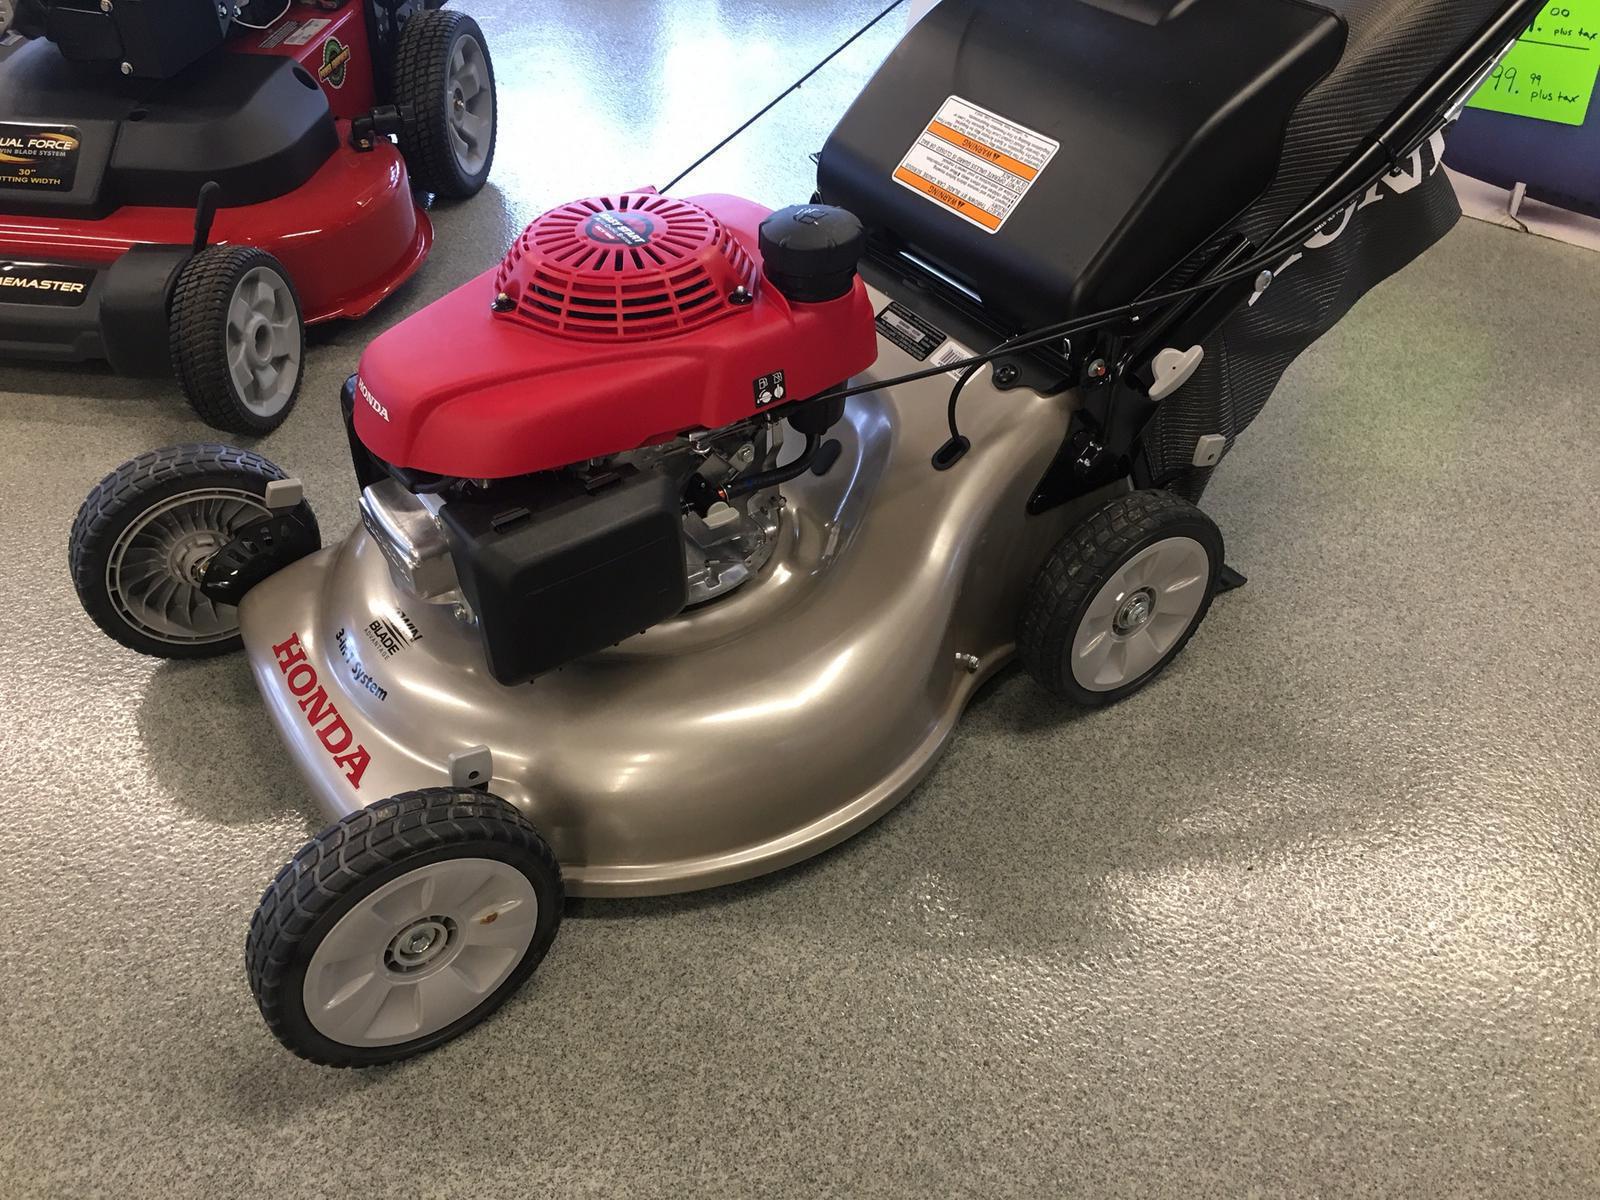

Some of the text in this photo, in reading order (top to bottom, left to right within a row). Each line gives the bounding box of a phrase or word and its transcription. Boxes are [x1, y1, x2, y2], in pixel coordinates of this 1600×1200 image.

[1554, 27, 1598, 40] plus tax
[1530, 89, 1579, 104] plus tax
[28, 139, 72, 150] FORCE
[935, 145, 952, 156] CLOSED
[960, 138, 993, 158] WARNING
[39, 150, 66, 158] SYSTEM
[956, 156, 971, 166] GUARD
[970, 163, 987, 174] UNLESS
[986, 171, 1006, 184] OPERATE
[1005, 180, 1015, 188] NOT
[926, 185, 958, 205] WARNING
[358, 377, 390, 423] HONDA
[364, 628, 390, 660] ADVANTAGE
[369, 620, 400, 656] BLADE
[352, 662, 388, 701] System
[272, 632, 373, 790] HONDA
